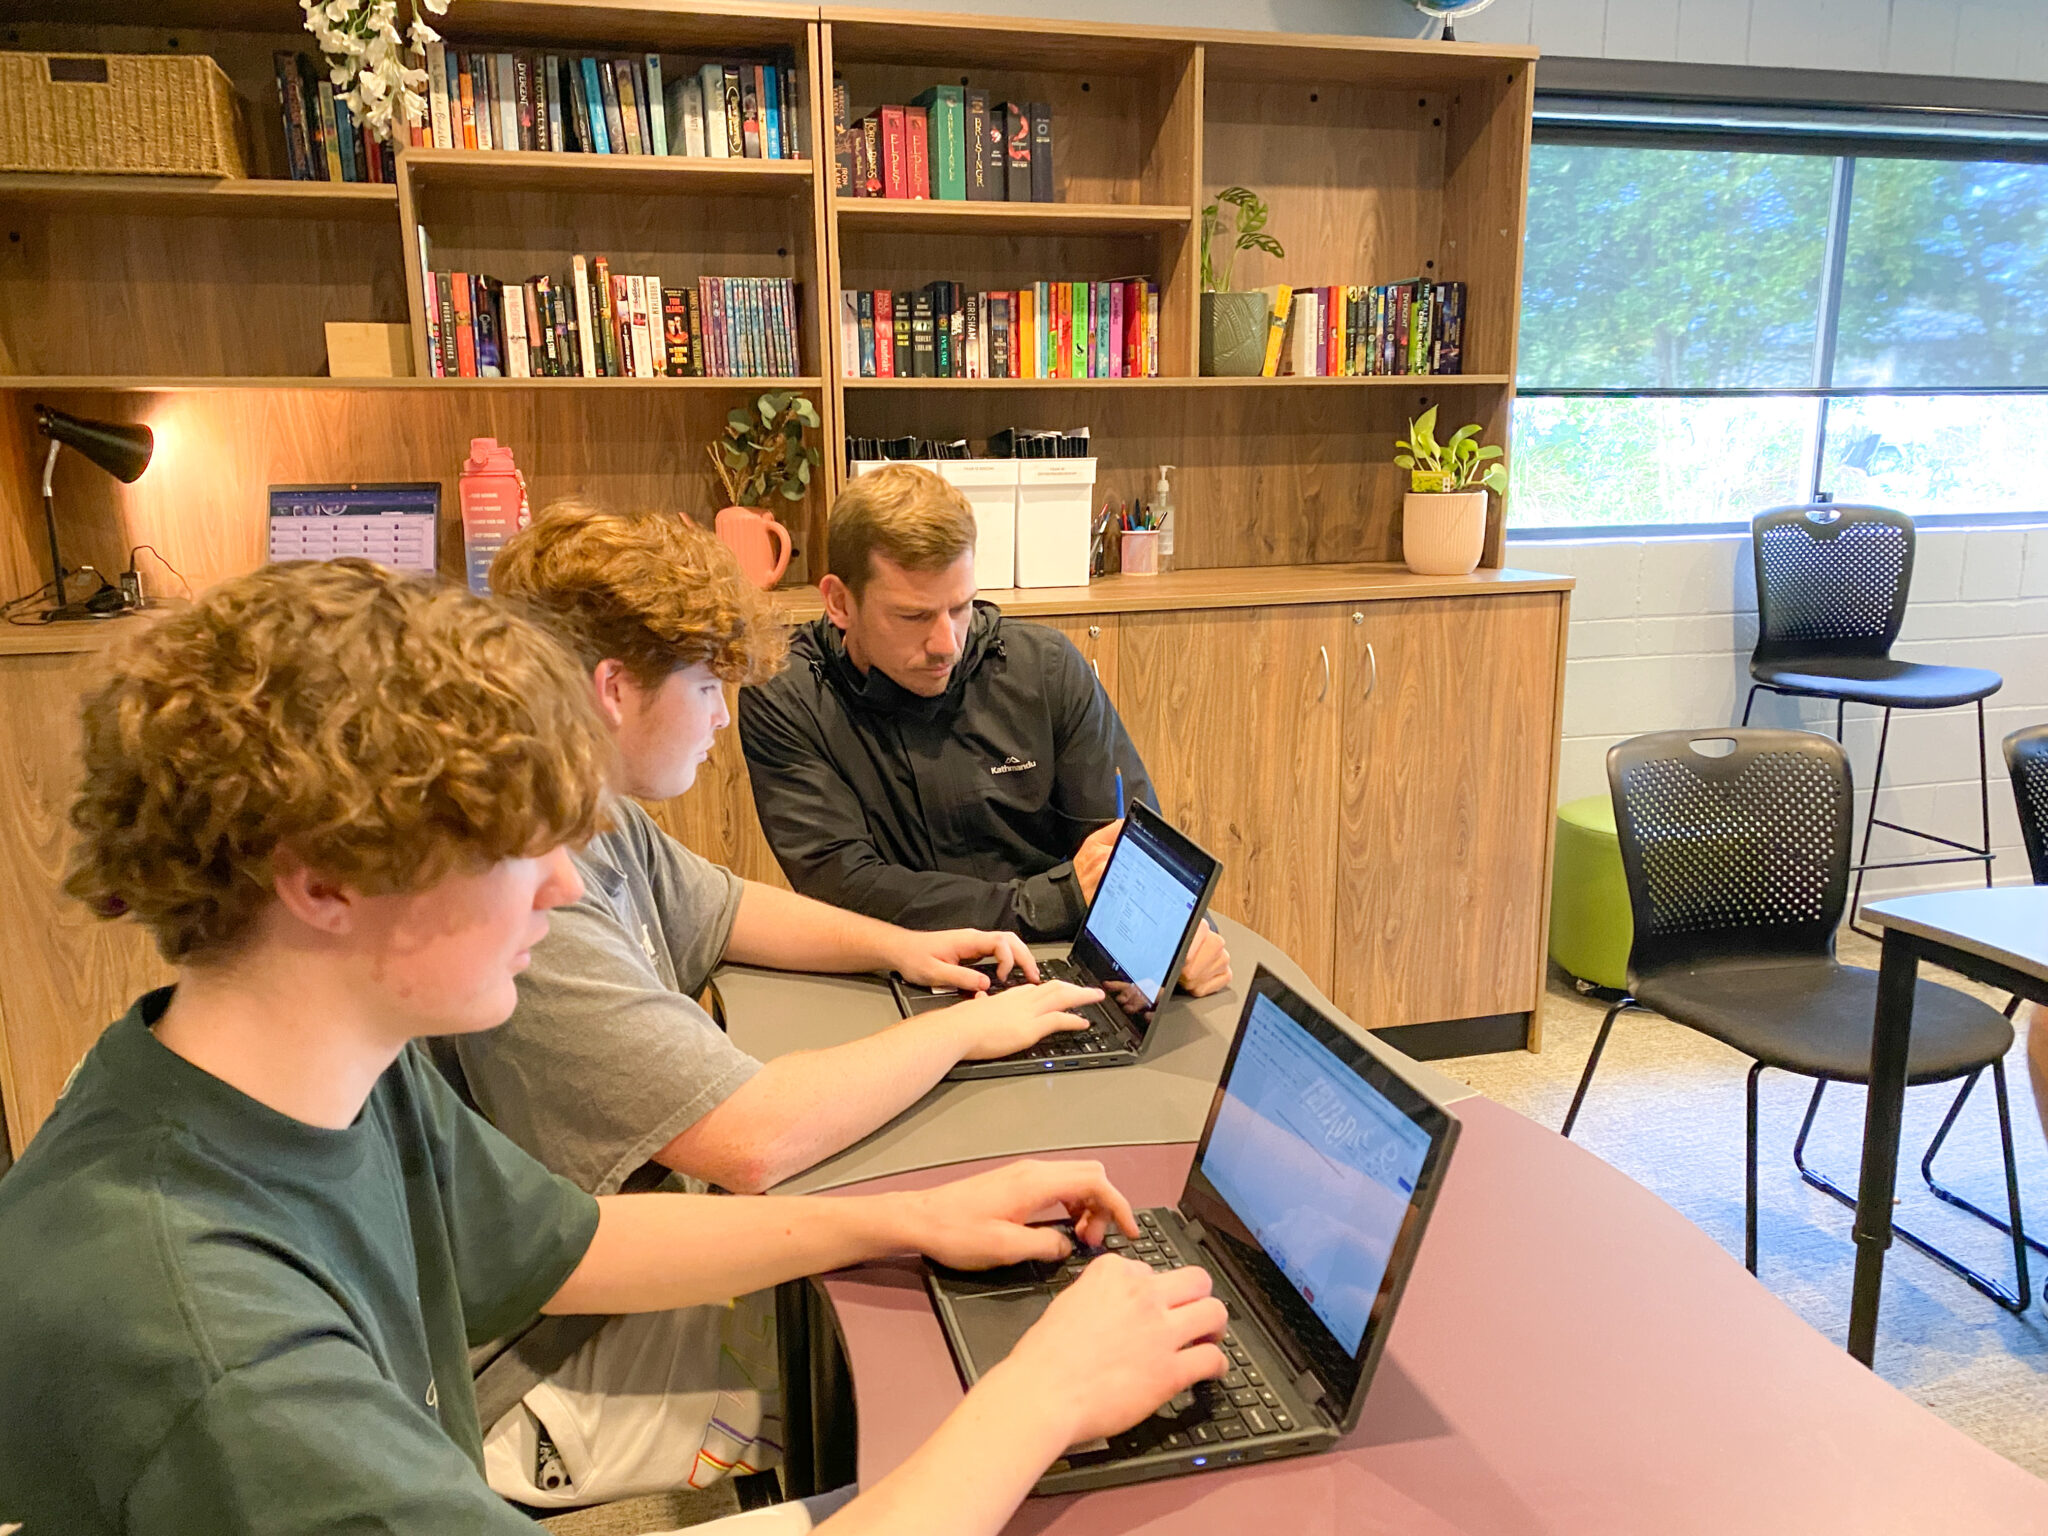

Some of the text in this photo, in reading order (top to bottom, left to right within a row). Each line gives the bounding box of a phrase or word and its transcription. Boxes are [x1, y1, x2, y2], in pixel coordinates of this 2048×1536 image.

[517, 62, 530, 106] DIVERGENT
[890, 133, 901, 191] ELDEST
[912, 135, 922, 192] ELDEST
[975, 117, 985, 188] BRISINGR
[967, 301, 977, 340] GRISHAM
[990, 760, 1037, 775] Kathmandu
